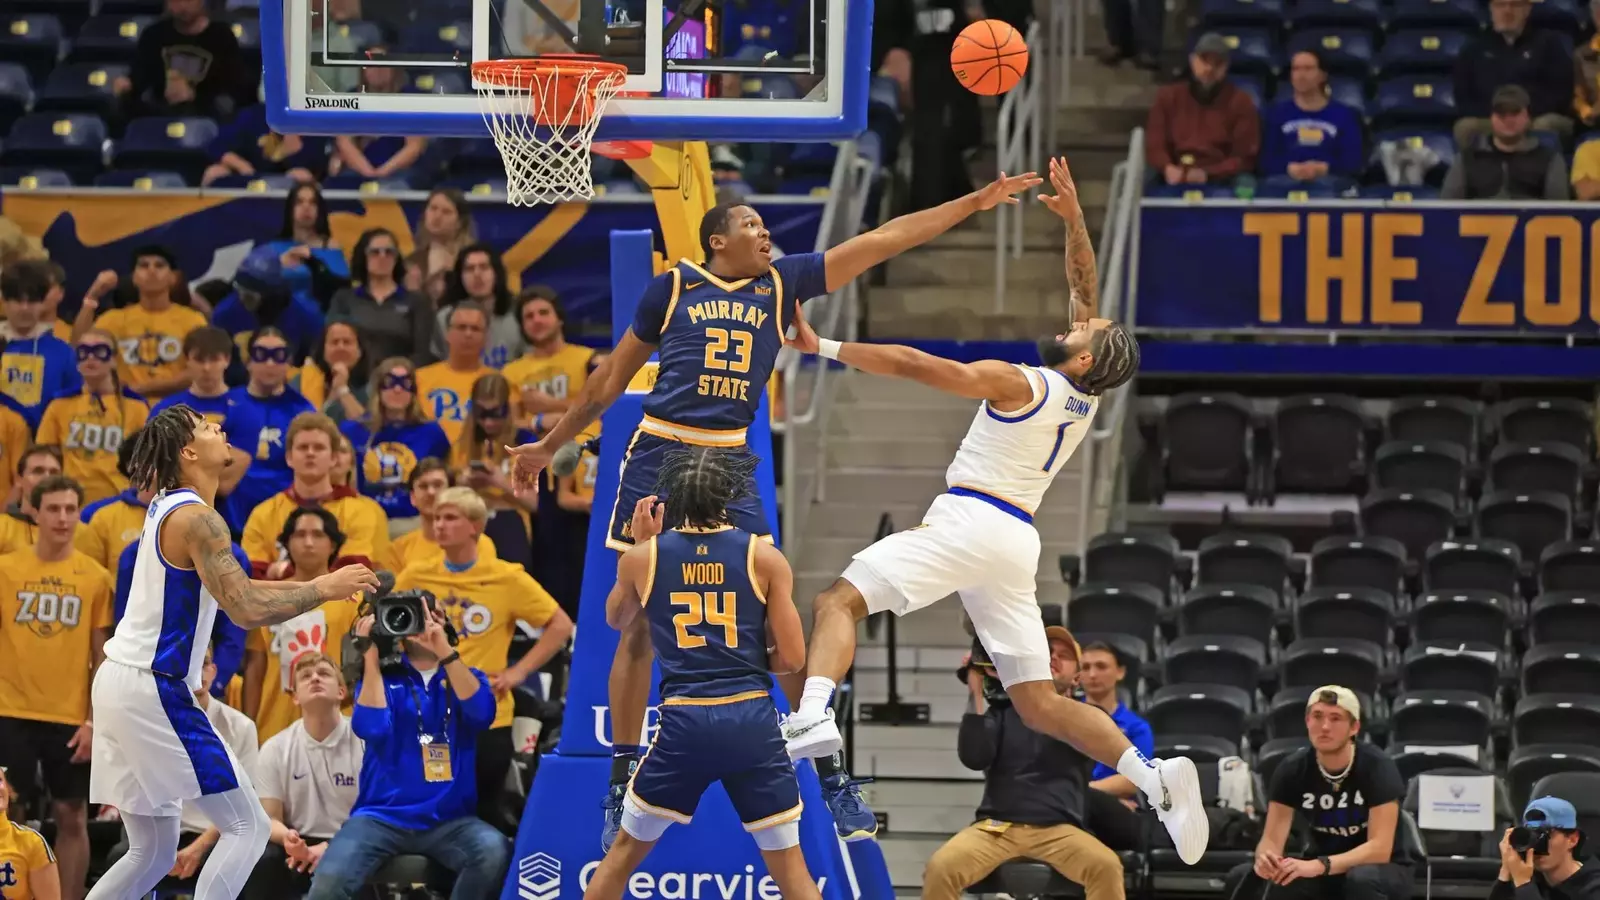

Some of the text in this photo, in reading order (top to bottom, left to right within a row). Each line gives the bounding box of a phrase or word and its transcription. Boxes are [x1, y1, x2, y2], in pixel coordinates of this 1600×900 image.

[305, 97, 360, 109] SPALDING
[1243, 214, 1600, 326] THE ZO
[686, 300, 768, 330] MURRAY
[703, 327, 753, 374] 23
[697, 374, 750, 401] STATE
[1064, 395, 1092, 417] DUNN
[66, 421, 124, 454] ZOO
[1041, 421, 1076, 473] 1
[681, 562, 725, 585] WOOD
[15, 590, 82, 629] ZOO
[670, 591, 739, 649] 24
[333, 772, 355, 787] Pitt
[1302, 789, 1365, 810] 2024
[579, 860, 827, 900] Cearvie
